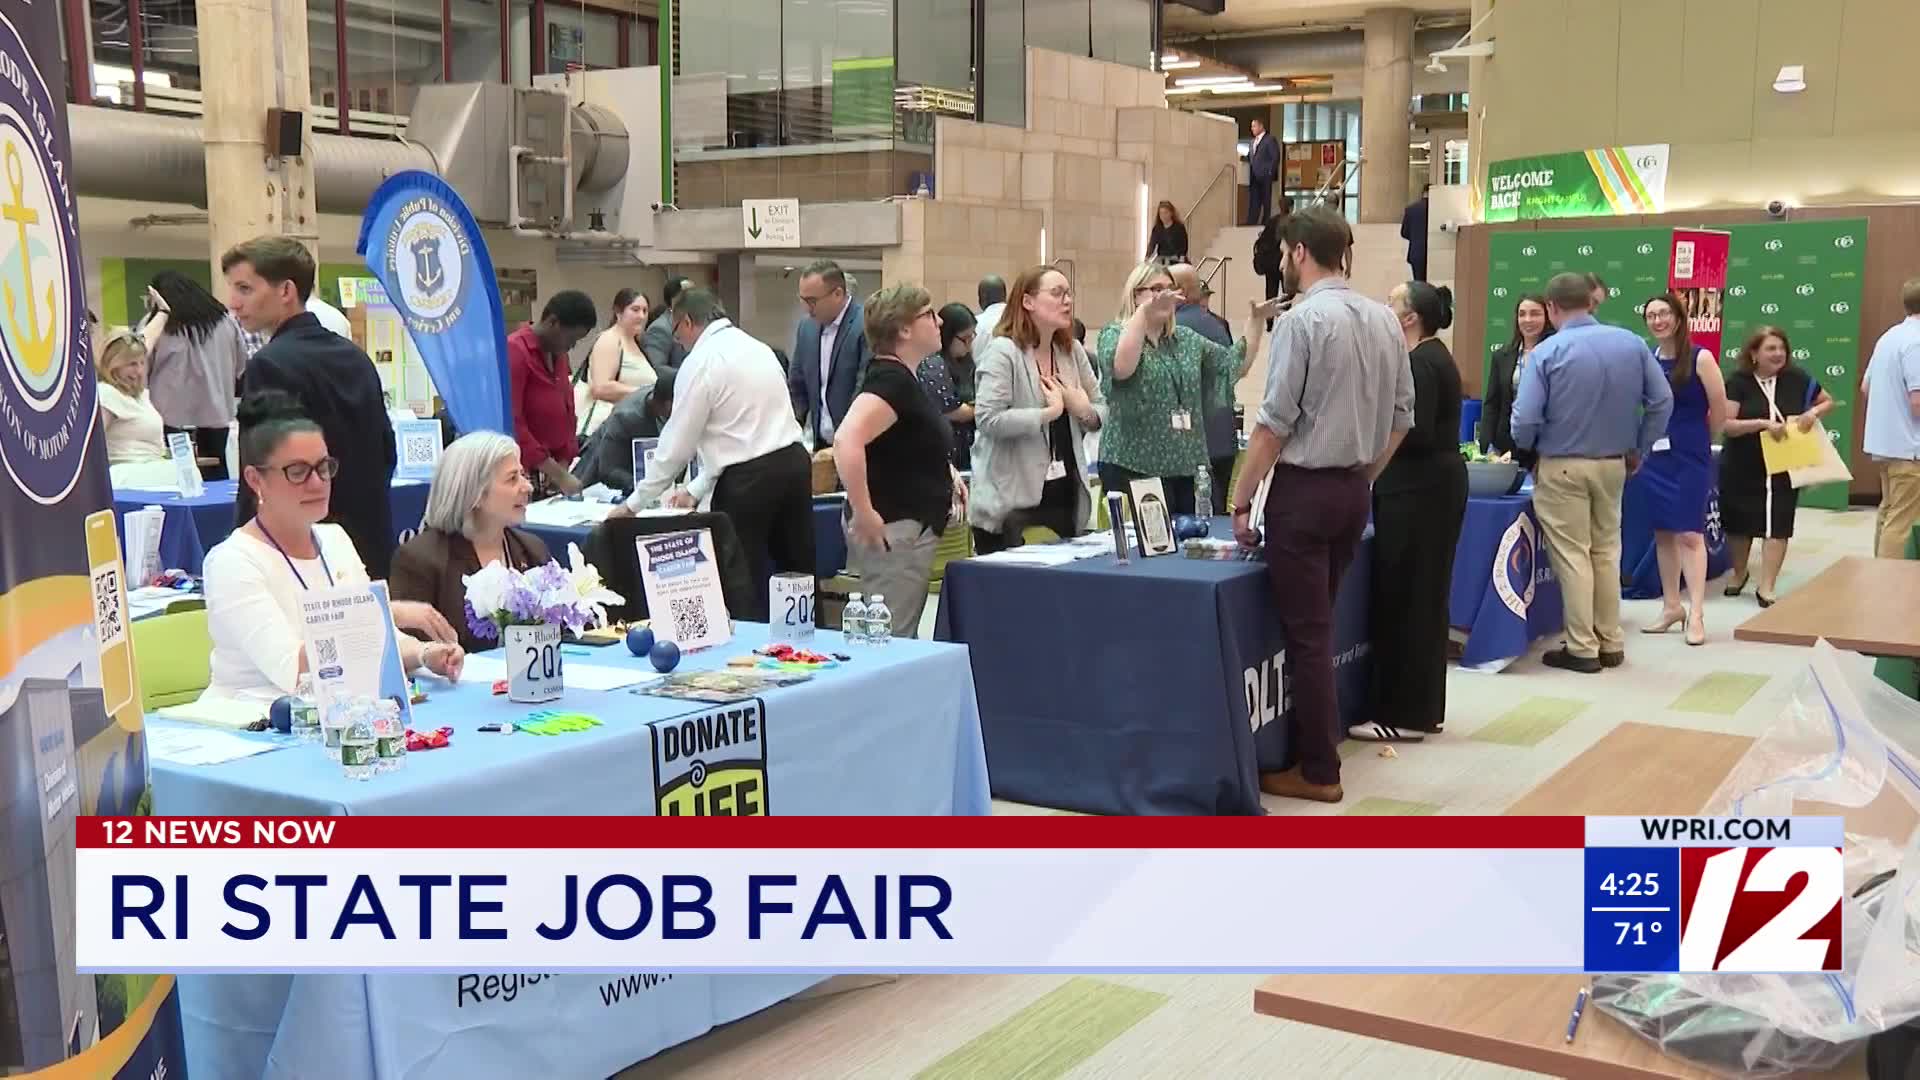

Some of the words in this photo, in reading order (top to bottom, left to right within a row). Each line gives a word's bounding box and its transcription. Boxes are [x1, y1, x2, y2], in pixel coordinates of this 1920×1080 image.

[0, 51, 31, 106] ODE
[1491, 169, 1554, 192] WELCOME
[768, 205, 789, 216] EXIT
[1490, 191, 1521, 209] BACK!
[1688, 312, 1721, 333] motion
[23, 429, 37, 457] OF
[39, 423, 71, 461] MOTOR
[65, 317, 89, 430] VEHICLES
[534, 628, 561, 643] Rhode
[664, 707, 757, 763] DONATE
